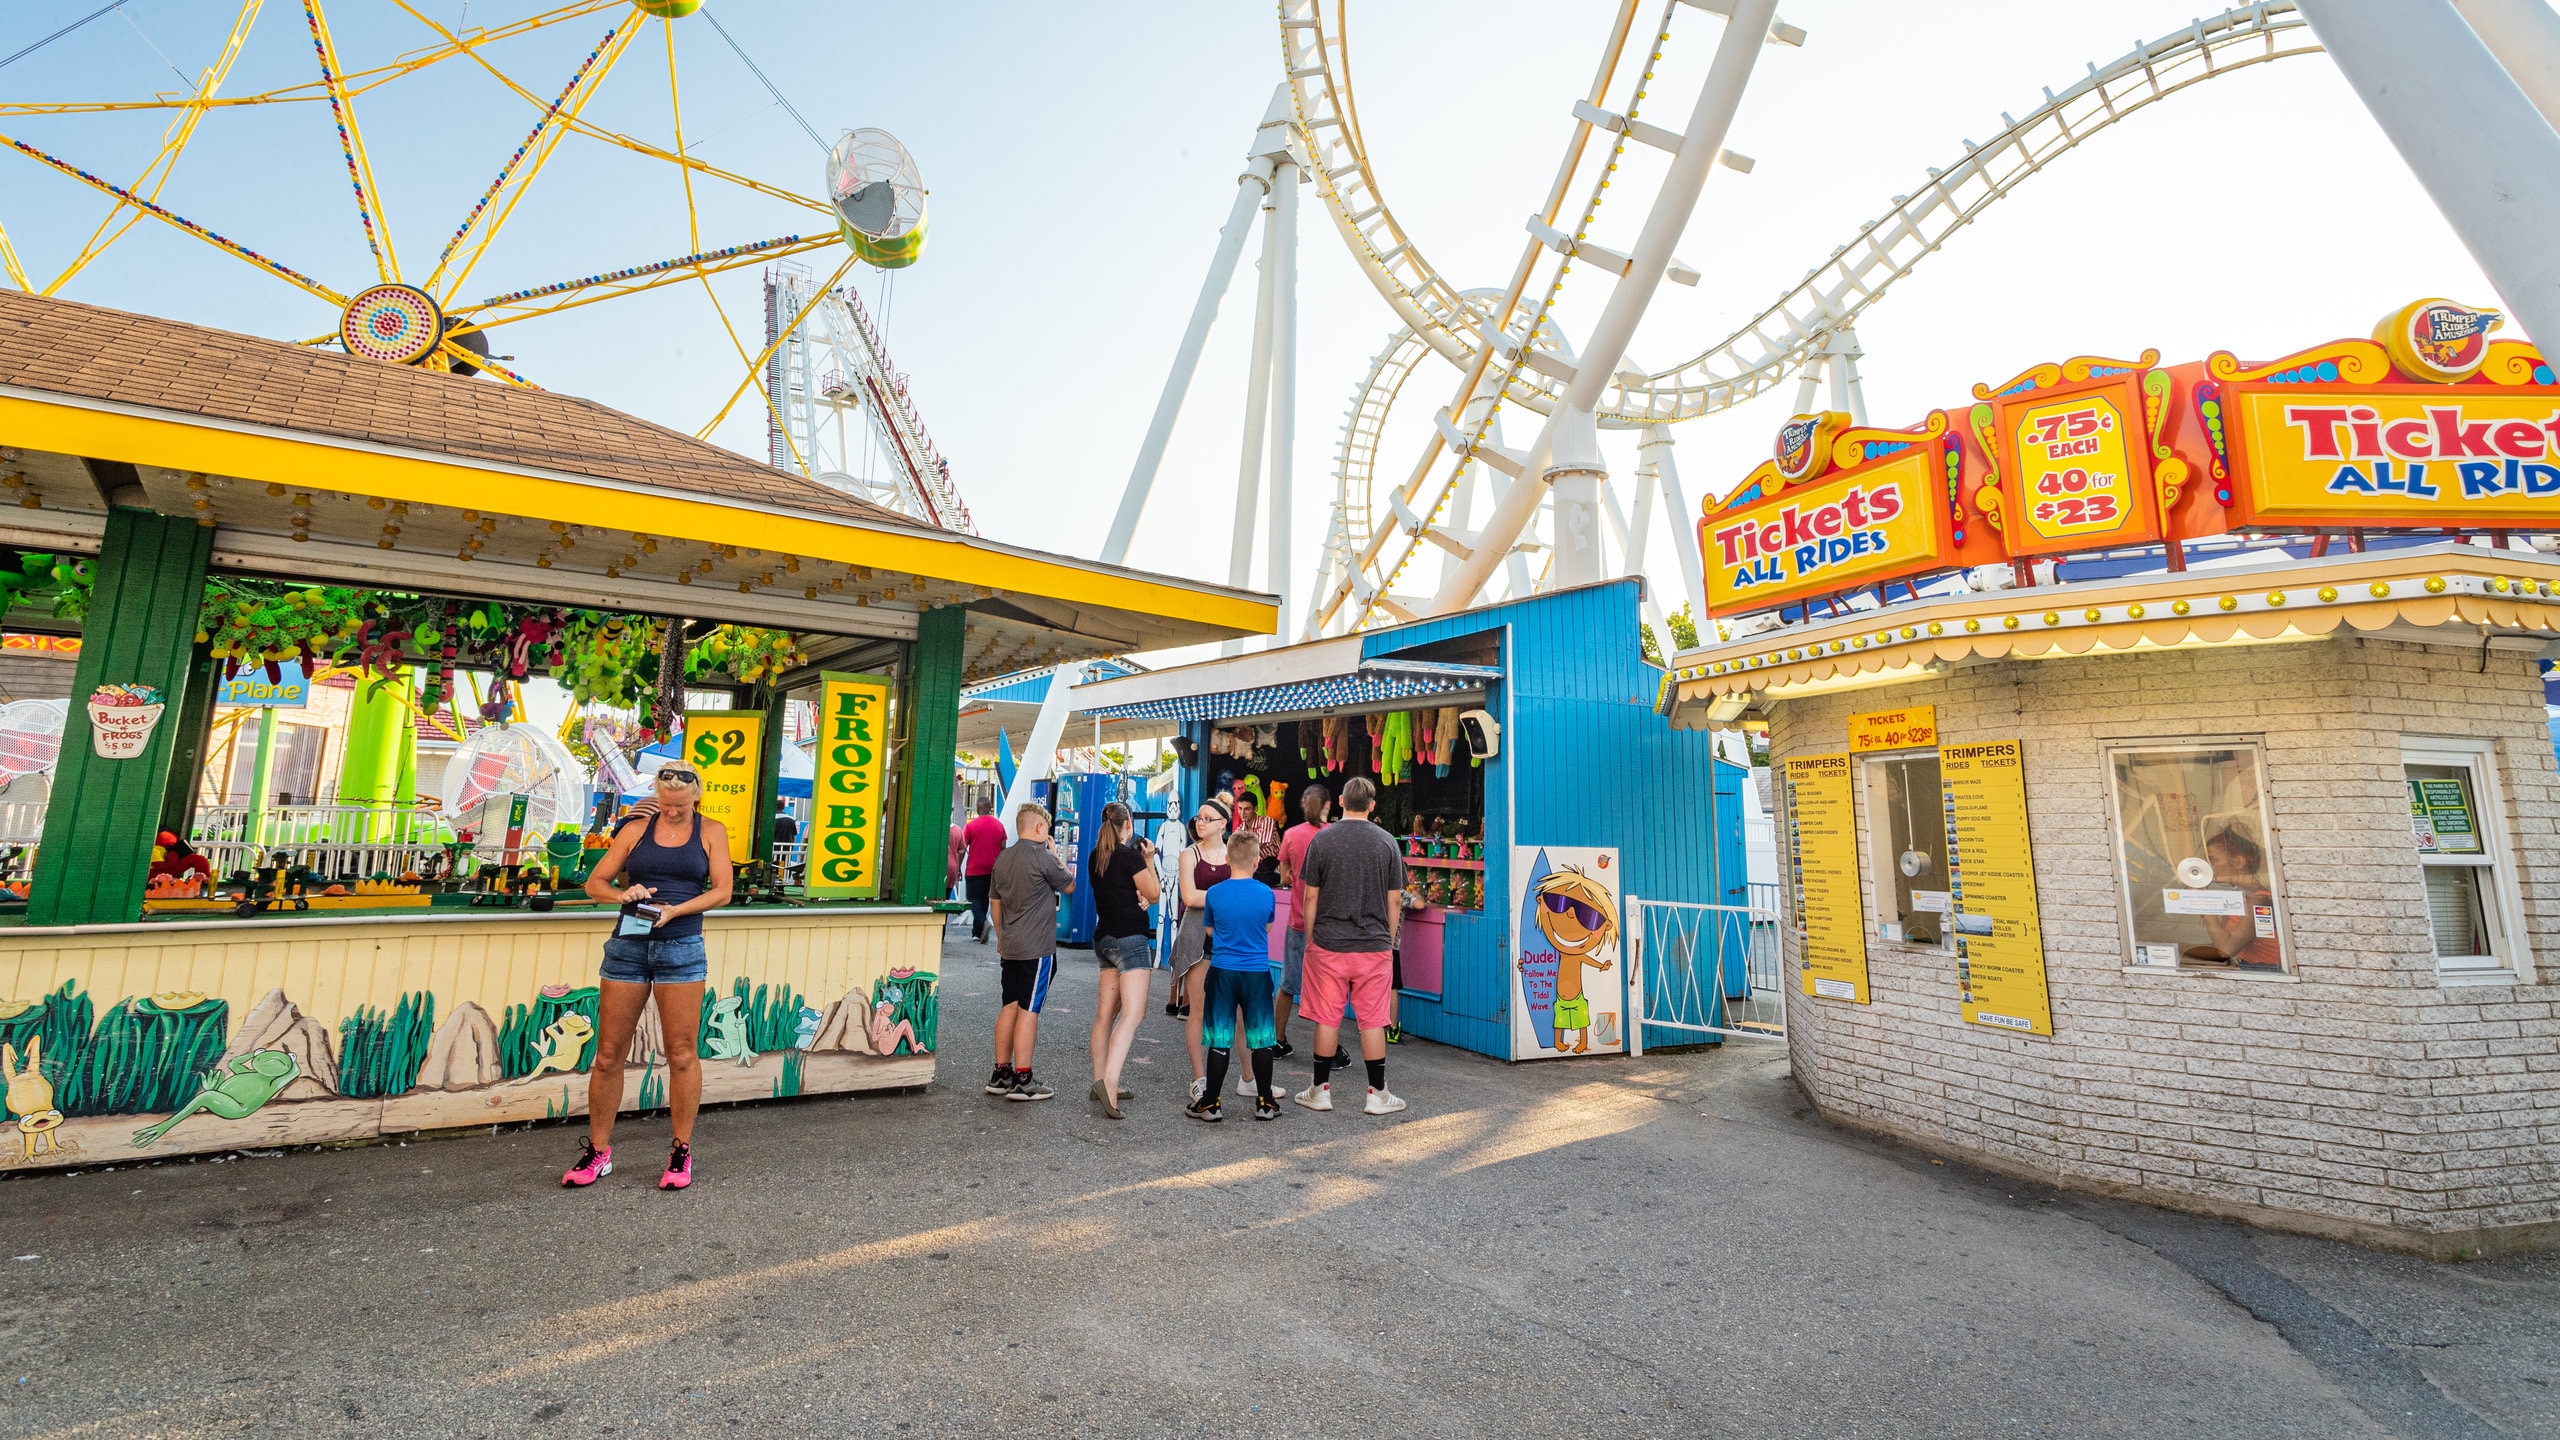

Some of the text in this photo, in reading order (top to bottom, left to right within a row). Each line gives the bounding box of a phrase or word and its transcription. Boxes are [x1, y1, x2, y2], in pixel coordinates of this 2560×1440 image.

[2430, 309, 2478, 323] TRIMPER
[2048, 437, 2098, 459] EACH
[2037, 468, 2114, 496] 40 for
[2327, 461, 2438, 497] ALL
[2035, 494, 2118, 526] $23
[1715, 486, 1901, 566] Tickets
[1733, 531, 1887, 588] ALL RIDES
[98, 711, 148, 725] Bucket
[1867, 713, 1906, 726] TICKETS
[102, 731, 143, 741] FROGS
[1885, 731, 1899, 746] 40
[693, 729, 746, 770] $2
[829, 692, 877, 795] FROG
[1943, 744, 2015, 760] TRIMPERS
[1788, 757, 1846, 771] TRIMPERS
[1946, 758, 2017, 769] RIDES TICKETS
[1818, 769, 1847, 777] TICKETS
[706, 781, 746, 796] frogs
[699, 805, 731, 814] RULES
[822, 804, 867, 884] BOG
[1523, 950, 1557, 964] Dude!
[1523, 969, 1557, 978] Follow Me
[1529, 980, 1552, 989] To The
[1532, 991, 1550, 1000] Tidal
[1530, 1003, 1551, 1011] Wave.
[1979, 1013, 1994, 1022] HAVE
[1994, 1015, 2006, 1024] FUN
[2014, 1019, 2029, 1028] SAFE
